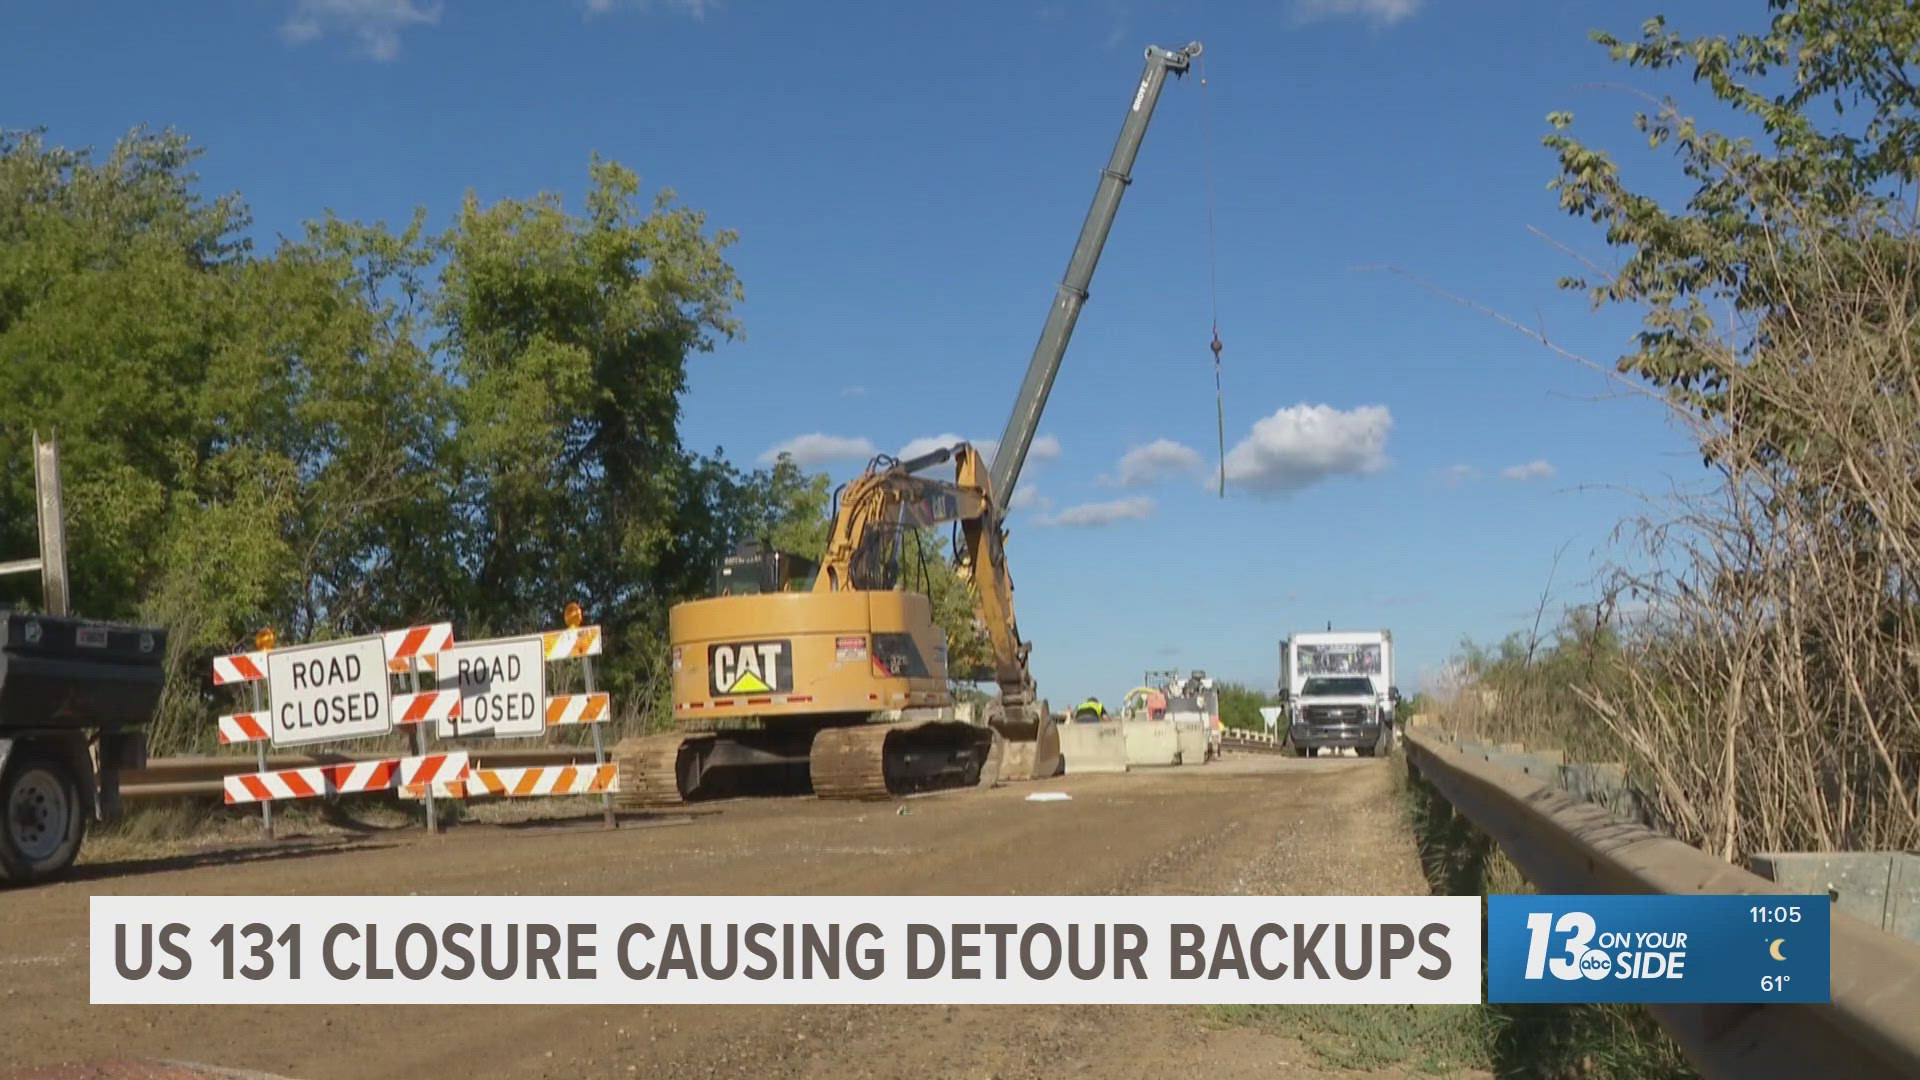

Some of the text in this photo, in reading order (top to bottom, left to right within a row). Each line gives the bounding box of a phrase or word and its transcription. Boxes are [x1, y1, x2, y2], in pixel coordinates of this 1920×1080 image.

[293, 655, 361, 690] ROAD
[458, 654, 521, 686] ROAD
[714, 645, 782, 693] CAT
[281, 692, 379, 730] CLOSED
[448, 692, 535, 724] LOSED
